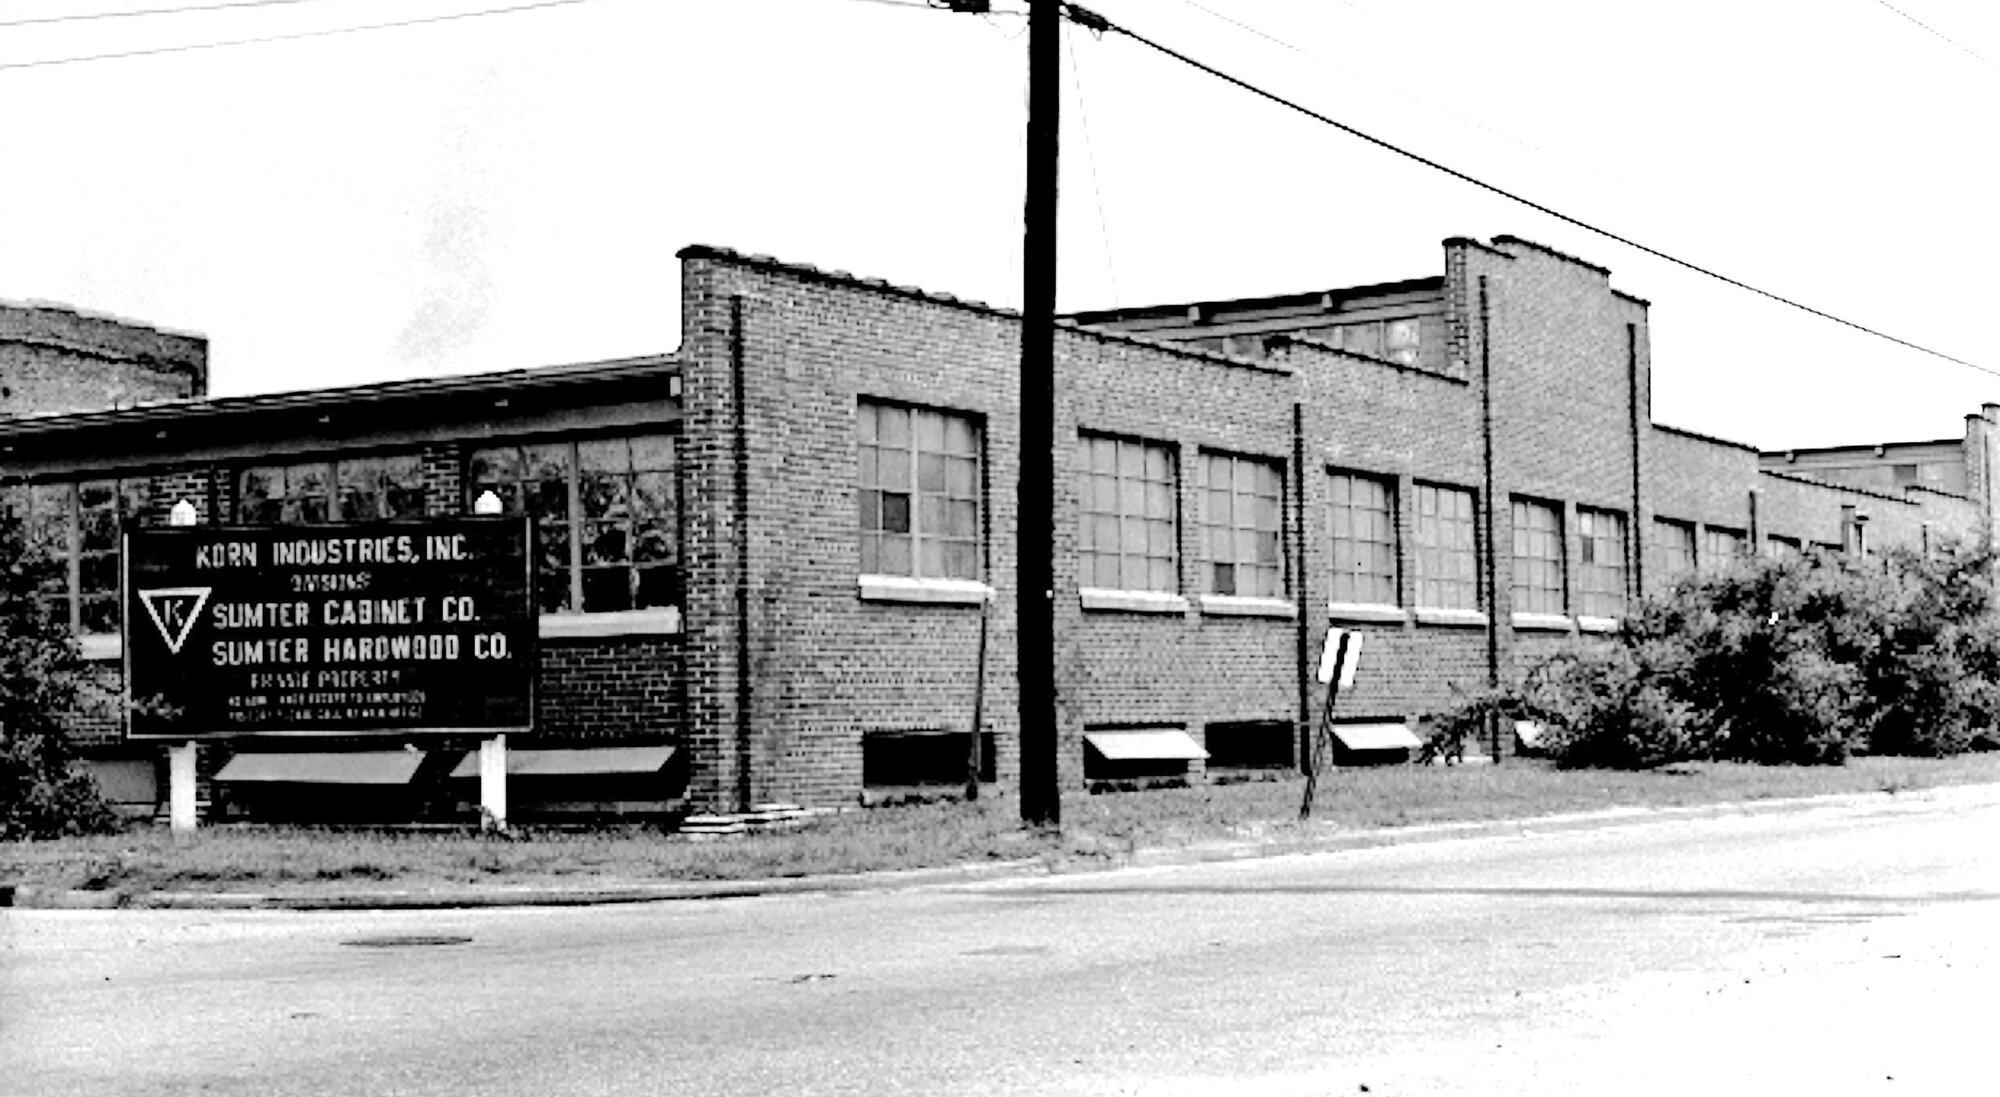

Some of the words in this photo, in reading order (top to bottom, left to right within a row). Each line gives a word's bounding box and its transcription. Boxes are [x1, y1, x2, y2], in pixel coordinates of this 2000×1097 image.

[195, 542, 257, 569] KORN
[273, 539, 420, 565] INDUSTRIES,
[426, 536, 474, 561] INC.
[212, 602, 310, 630] SUMTER
[323, 597, 426, 625] CABINET
[442, 596, 481, 623] CO.
[212, 637, 309, 666] SUMTER
[323, 634, 459, 663] HARDWOOD
[474, 632, 512, 660] CO.
